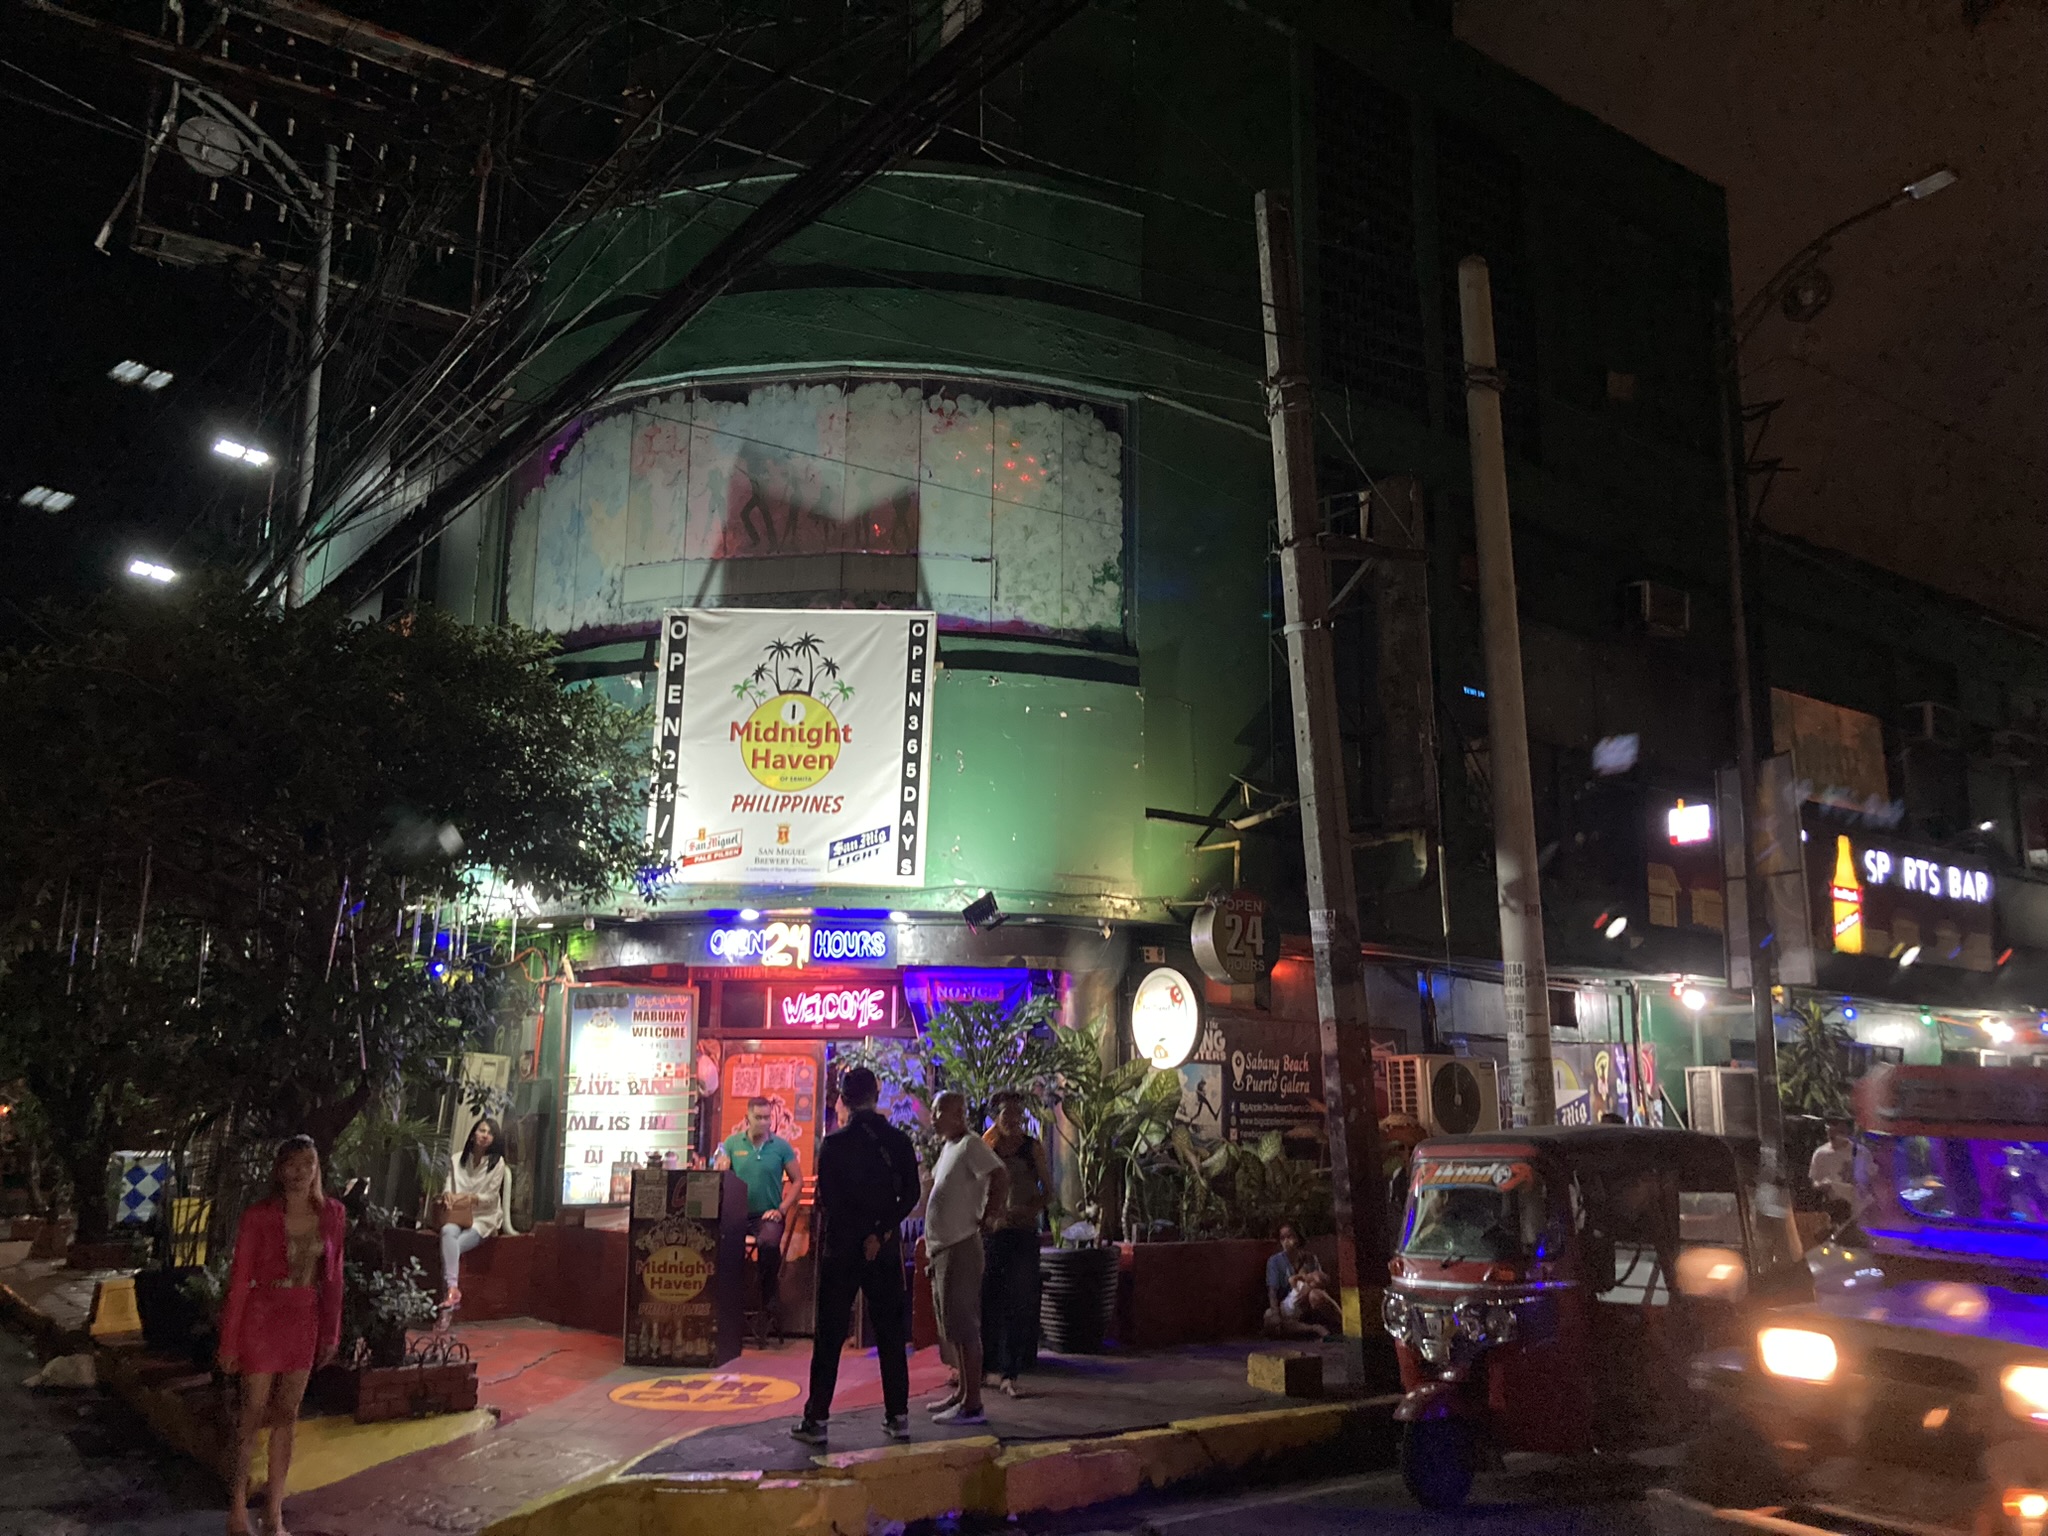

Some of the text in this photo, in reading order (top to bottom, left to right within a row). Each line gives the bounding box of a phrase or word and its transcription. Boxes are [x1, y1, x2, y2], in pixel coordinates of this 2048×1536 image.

[729, 720, 853, 749] Midnight
[751, 748, 835, 770] Haven
[731, 794, 845, 814] PHILIPPINES
[688, 833, 739, 852] San Miguel
[758, 847, 774, 856] SAN
[833, 829, 887, 857] San Mig
[694, 848, 739, 863] PALE PILSEN
[754, 857, 790, 865] BREWERY
[837, 848, 881, 867] LIGHT
[1864, 849, 1989, 902] SPRTS BAR
[1226, 900, 1263, 912] OPEN
[1225, 914, 1265, 956] 24
[762, 922, 811, 969] 24
[813, 929, 886, 959] HOURS
[1226, 959, 1265, 972] HOURS
[633, 1010, 687, 1023] MABUHAY
[782, 988, 885, 1029] WELCOME
[632, 1027, 686, 1038] WELCOME
[1245, 1050, 1309, 1079] Sabang Beach
[1245, 1072, 1310, 1098] Puerto Galera
[636, 1260, 715, 1277] Midnight
[650, 1276, 704, 1291] Haven
